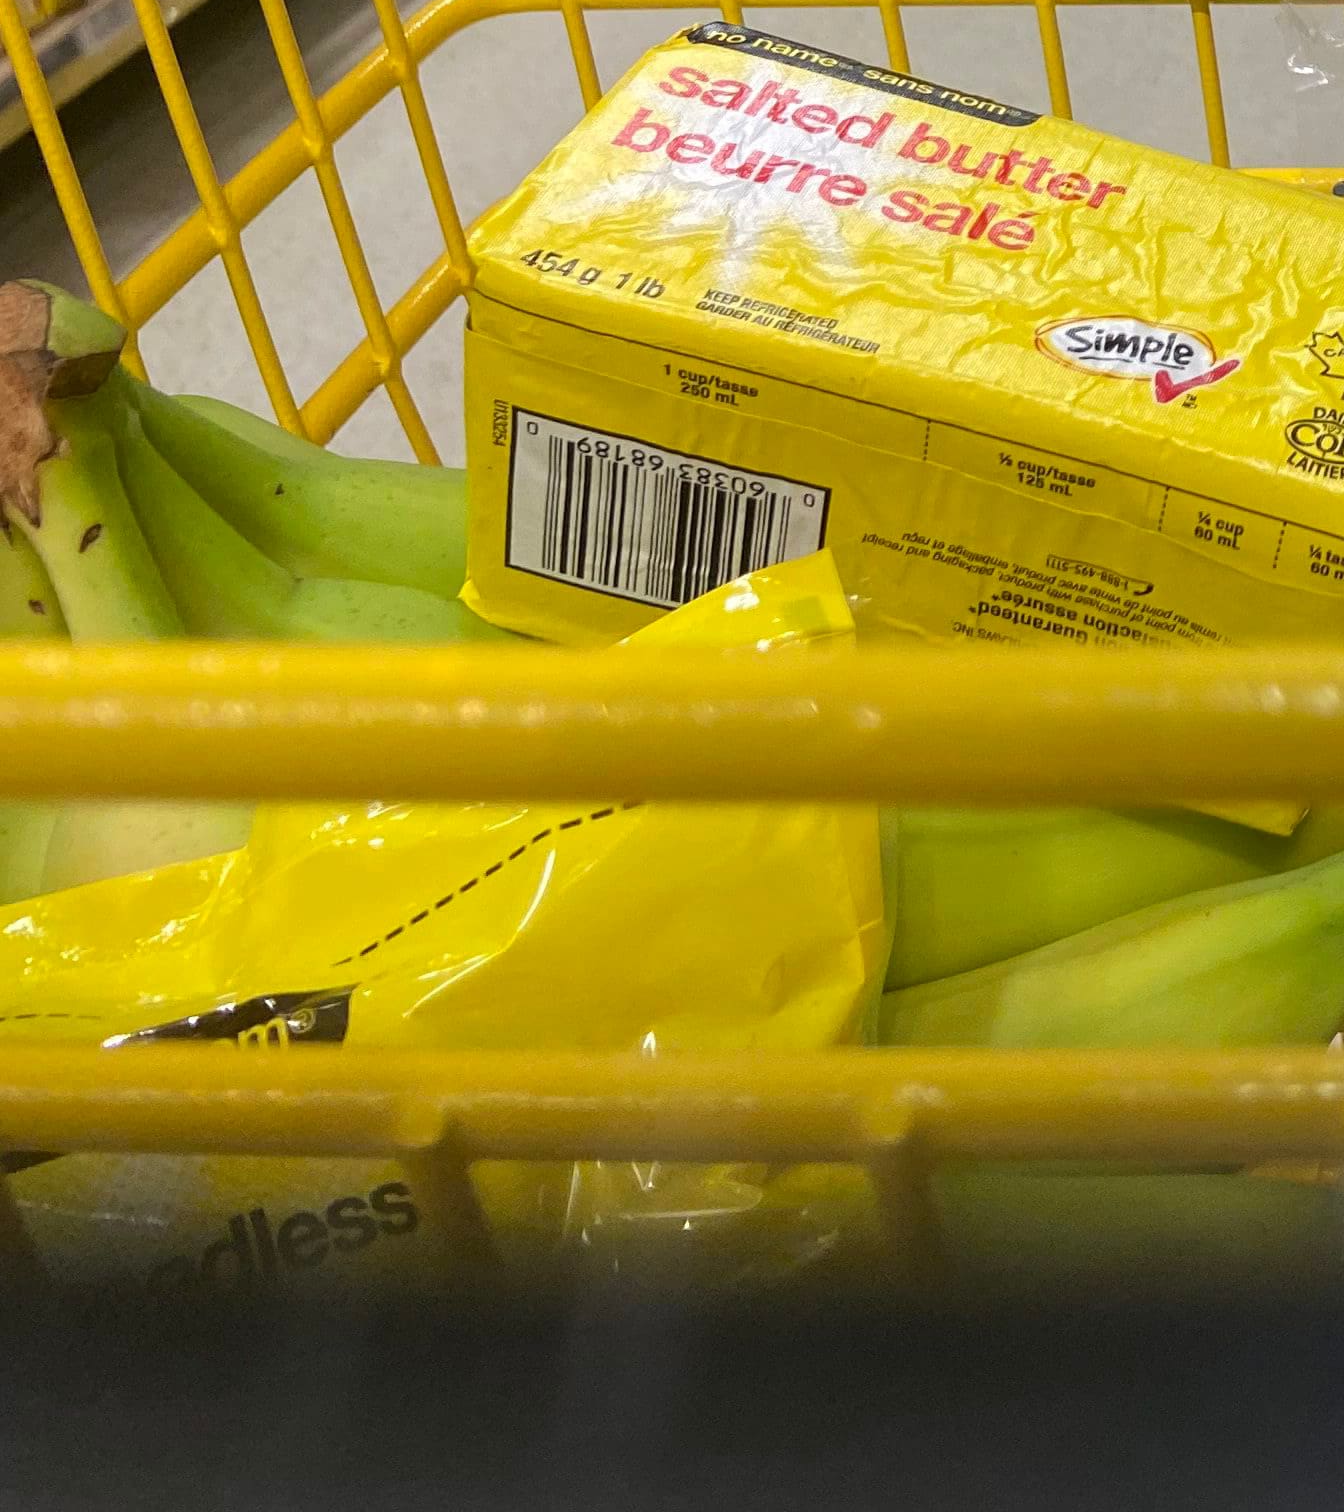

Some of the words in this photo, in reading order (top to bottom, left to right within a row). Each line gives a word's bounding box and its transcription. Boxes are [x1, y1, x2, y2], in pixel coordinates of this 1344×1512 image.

[707, 28, 748, 45] no
[862, 66, 932, 96] sans
[659, 63, 897, 150] salted
[898, 122, 1128, 209] butter
[611, 107, 867, 207] beurre
[882, 187, 1037, 252] salé
[520, 248, 578, 278] 454
[579, 265, 601, 286] g
[615, 271, 633, 291] 1
[633, 275, 666, 300] lb
[695, 300, 751, 323] GARDER
[752, 314, 774, 329] AU
[702, 288, 741, 307] KEEP
[741, 298, 839, 333] REFRIGERATED
[1065, 324, 1195, 367] Simple
[664, 364, 672, 376] 1
[678, 368, 759, 398] cup/tasse
[680, 383, 711, 399] 250
[715, 392, 740, 407] mL
[577, 437, 665, 472] 68189
[679, 463, 766, 498] 60383
[1017, 460, 1096, 489] cup/tasse
[1017, 472, 1045, 489] 125
[1049, 480, 1073, 497] mL
[803, 493, 815, 508] 0
[1193, 524, 1214, 541] 60
[1217, 533, 1241, 550] mL
[1215, 519, 1245, 537] cup
[862, 533, 905, 556] receipt
[905, 545, 931, 562] and
[948, 544, 1009, 571] emballage
[932, 549, 995, 578] packaging
[1309, 559, 1330, 575] 60
[1059, 578, 1088, 595] avec
